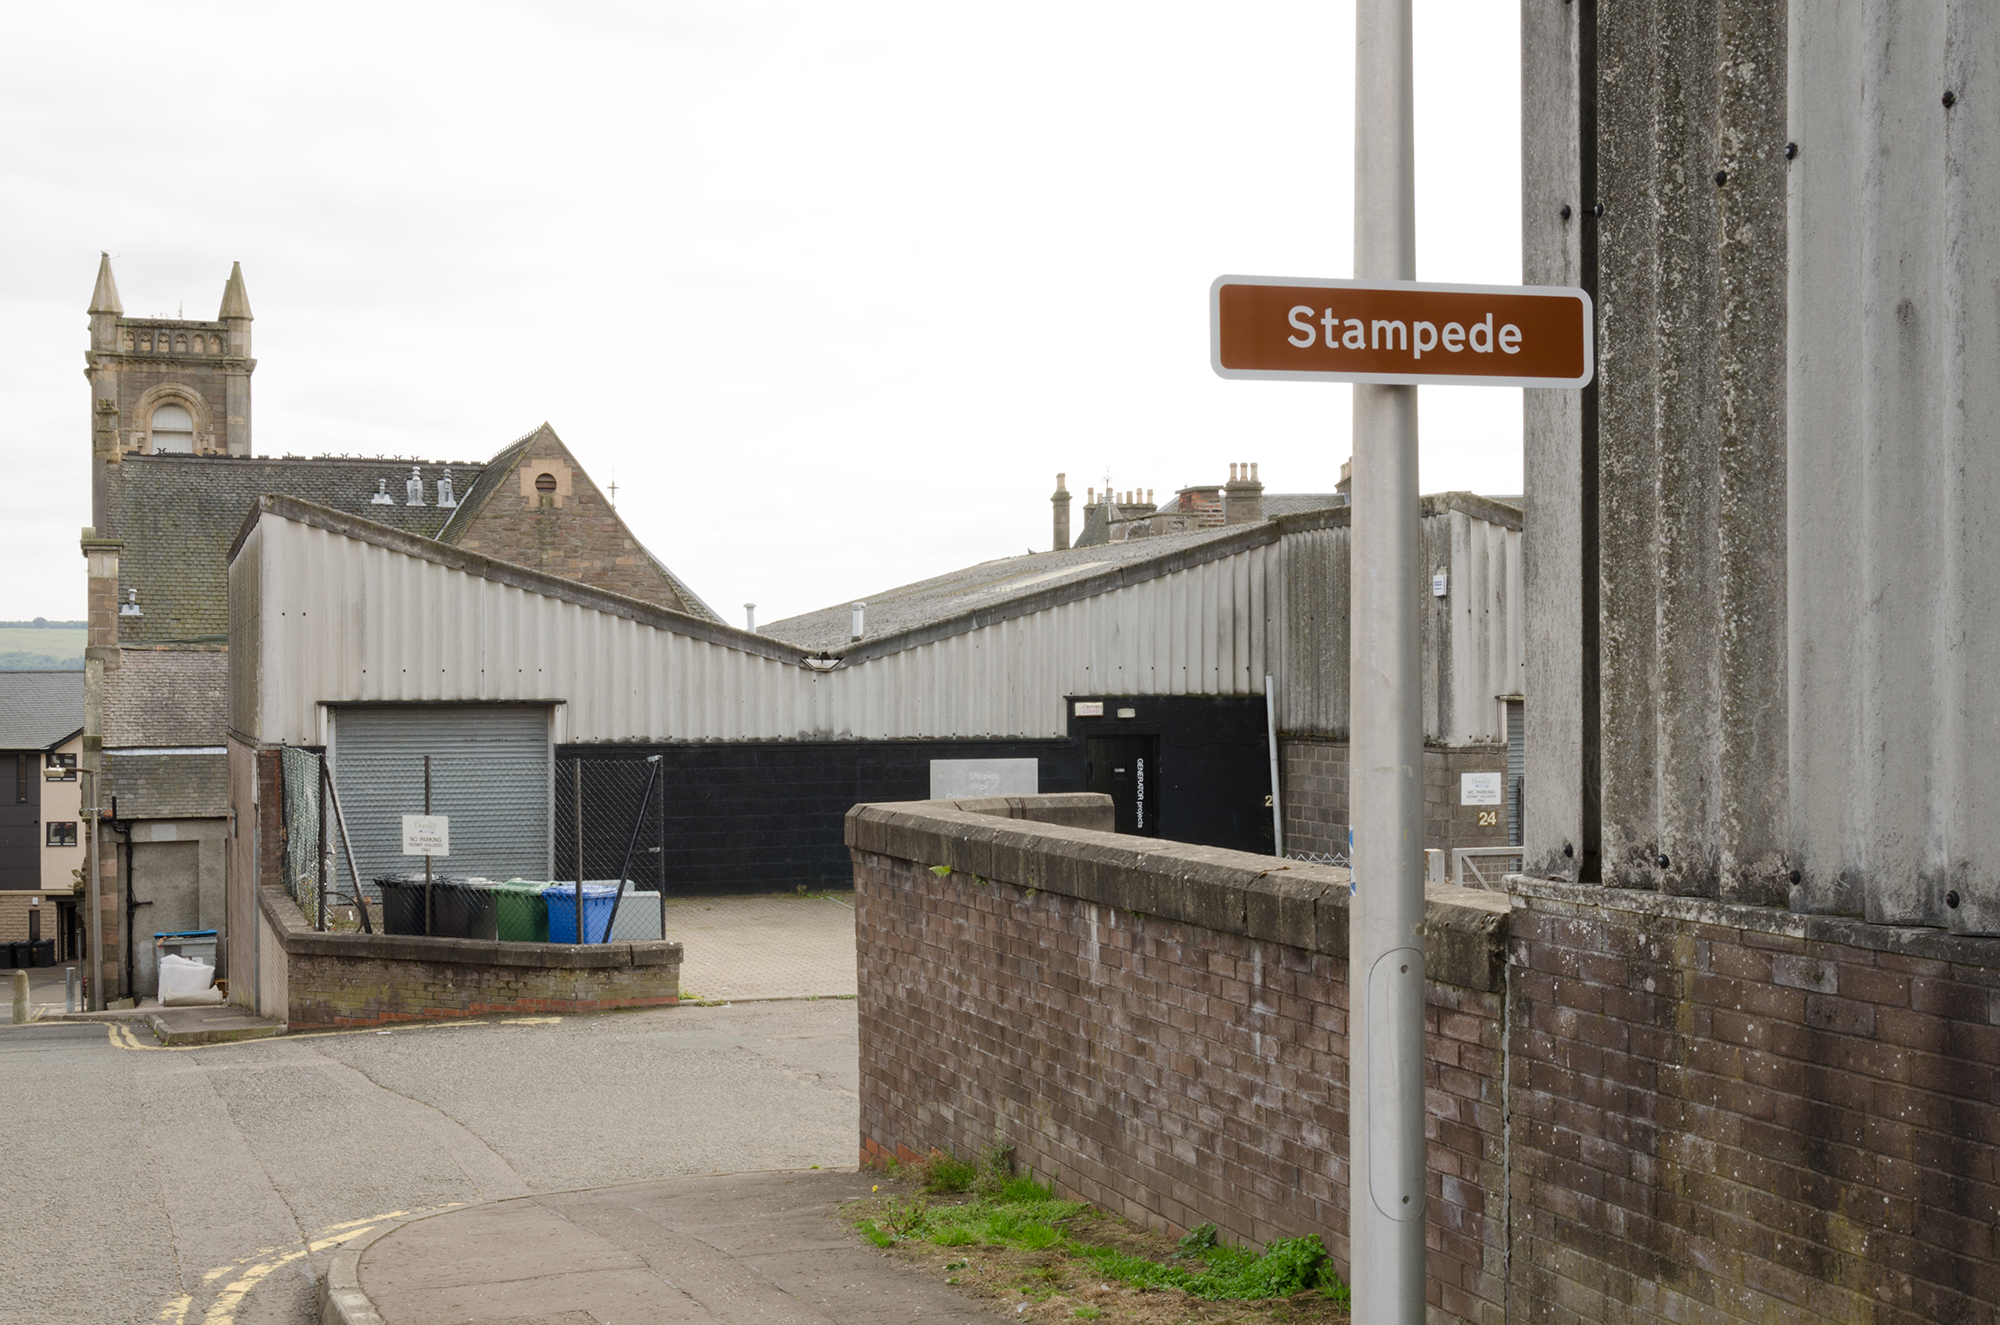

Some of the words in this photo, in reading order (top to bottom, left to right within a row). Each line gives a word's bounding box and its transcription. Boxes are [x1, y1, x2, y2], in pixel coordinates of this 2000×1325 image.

[1287, 305, 1522, 359] Stampede
[970, 772, 998, 780] Utopias
[980, 782, 988, 790] of
[1136, 801, 1144, 829] projects
[1479, 811, 1496, 825] 24
